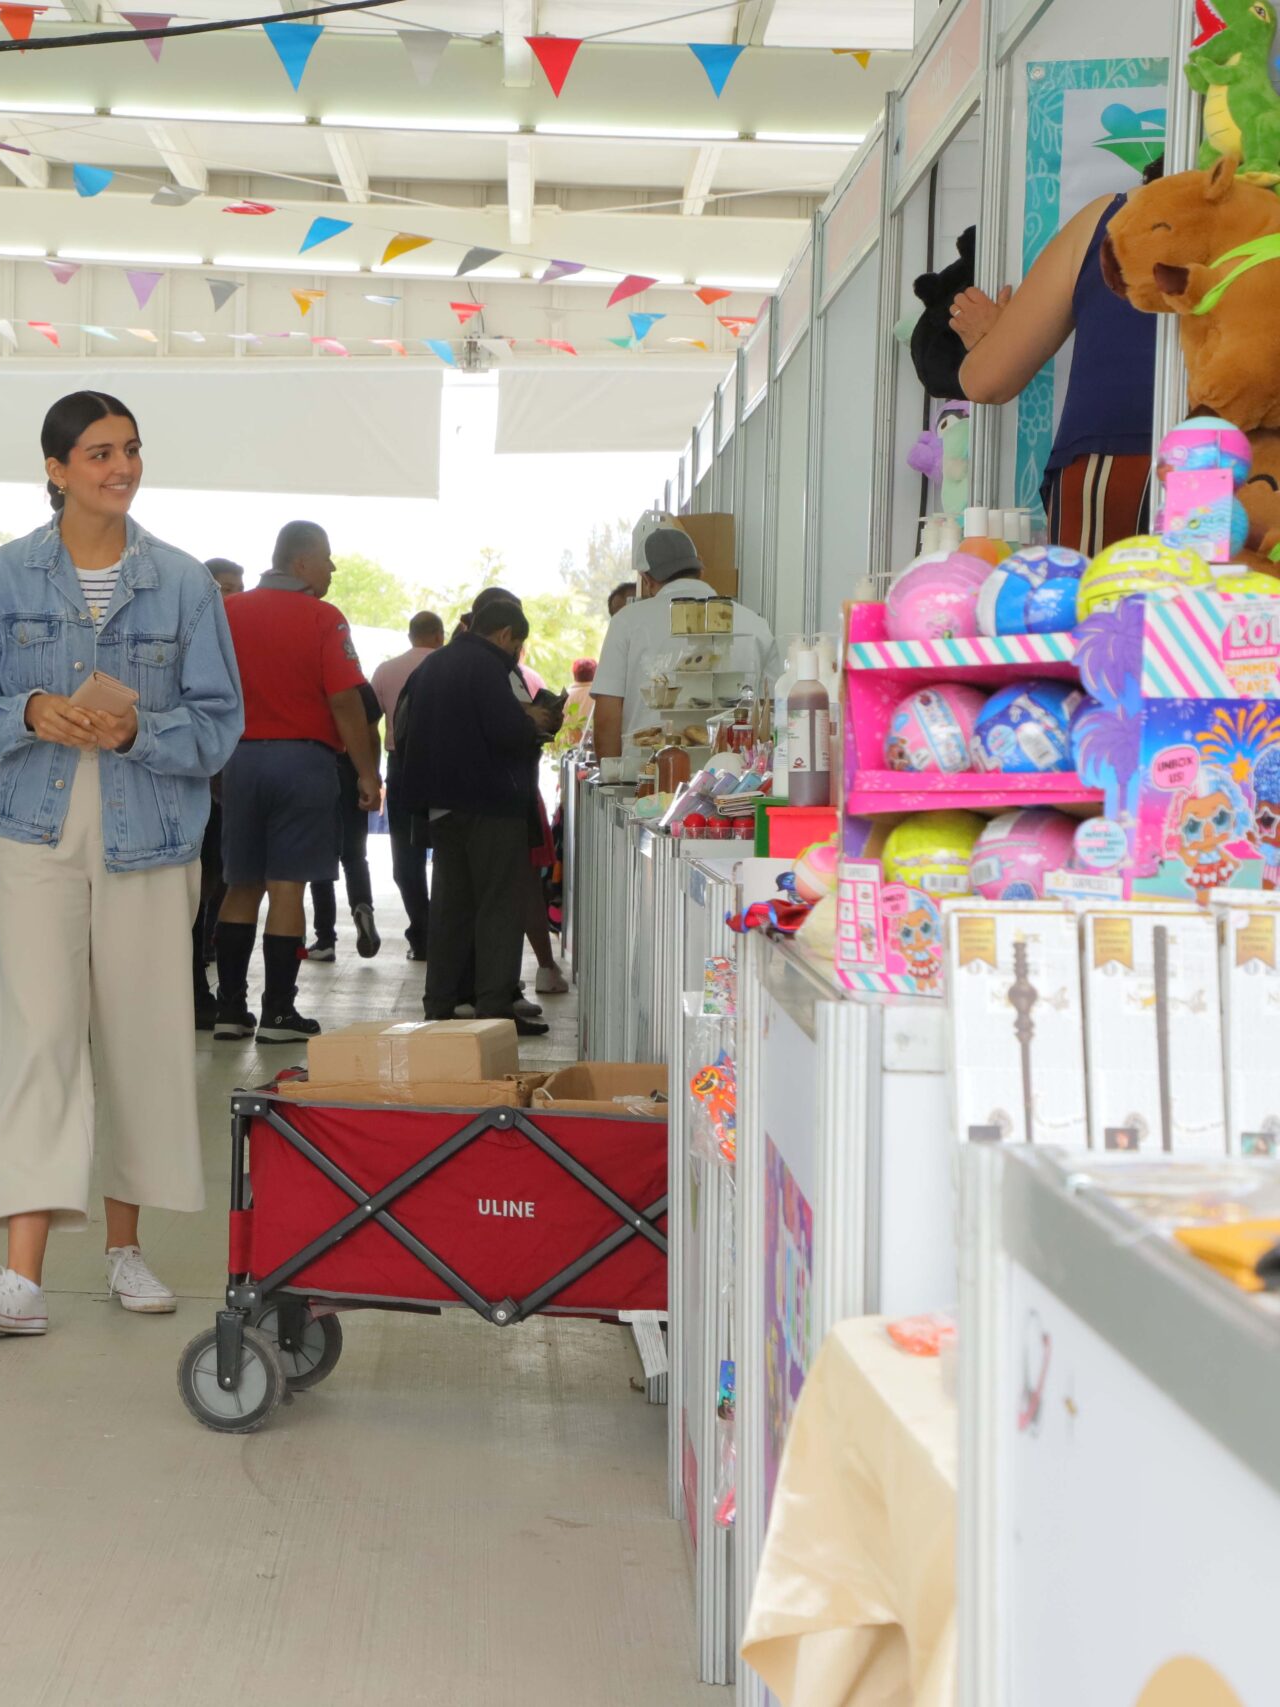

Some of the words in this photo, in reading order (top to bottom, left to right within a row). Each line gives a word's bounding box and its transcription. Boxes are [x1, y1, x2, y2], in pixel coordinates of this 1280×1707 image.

[1226, 661, 1276, 676] SUMMER
[1158, 756, 1194, 772] UNBOX
[478, 1199, 535, 1218] ULINE
